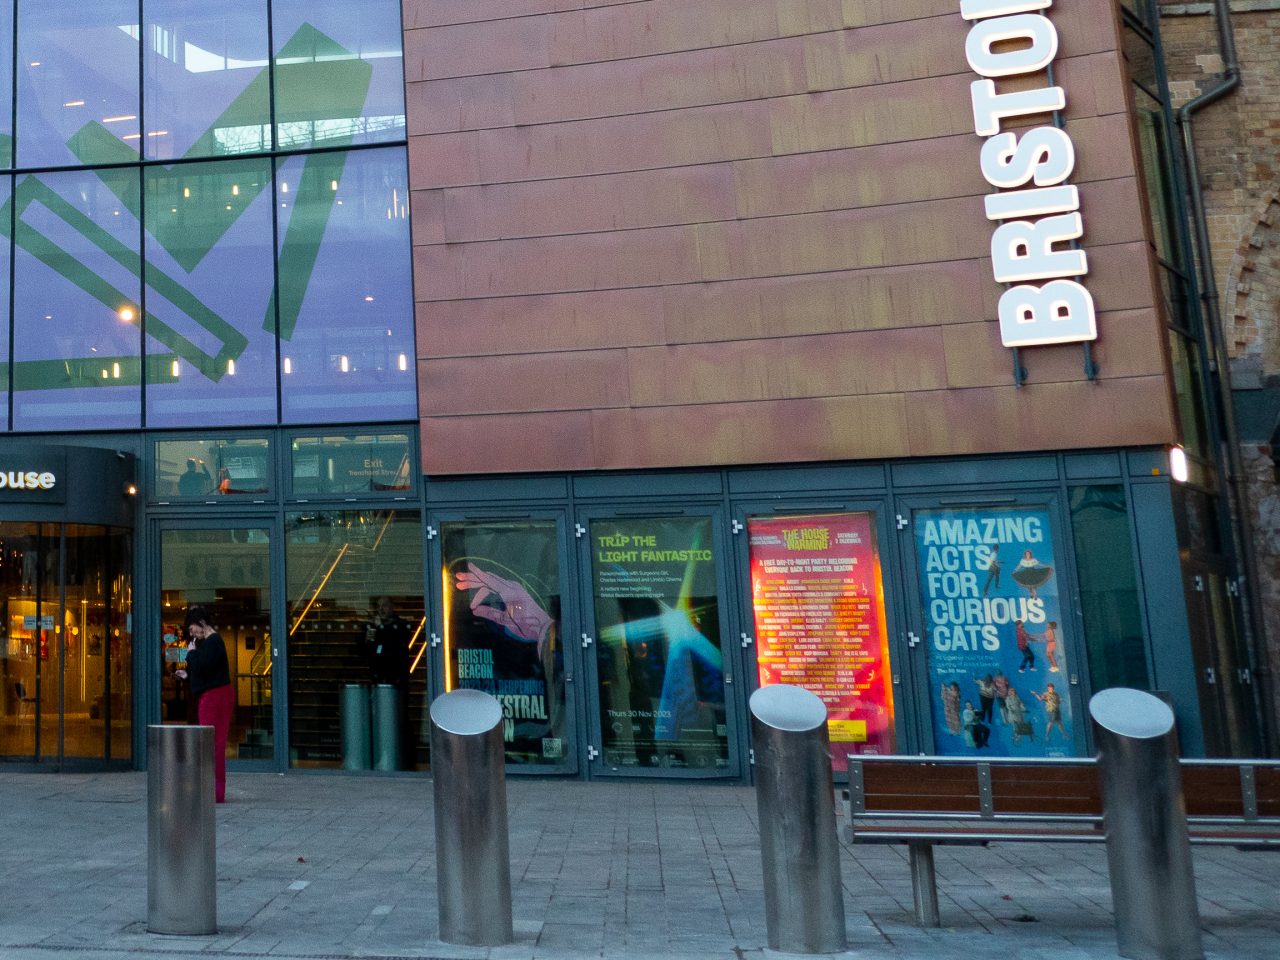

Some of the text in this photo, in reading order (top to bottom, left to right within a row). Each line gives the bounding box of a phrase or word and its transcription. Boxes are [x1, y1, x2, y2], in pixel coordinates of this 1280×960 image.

[364, 459, 383, 468] Exit
[782, 528, 830, 540] THE HOUSE
[923, 517, 1043, 545] AMAZING
[599, 533, 657, 547] TRIP THE
[787, 538, 829, 551] WARMING
[599, 550, 712, 562] LIGHT FANTASTIC
[926, 545, 991, 571] ACTS
[928, 572, 979, 598] FOR
[930, 598, 1046, 624] CURIOUS
[933, 625, 1000, 651] CATS
[458, 648, 494, 664] BRISTOL
[458, 663, 494, 679] BEACON
